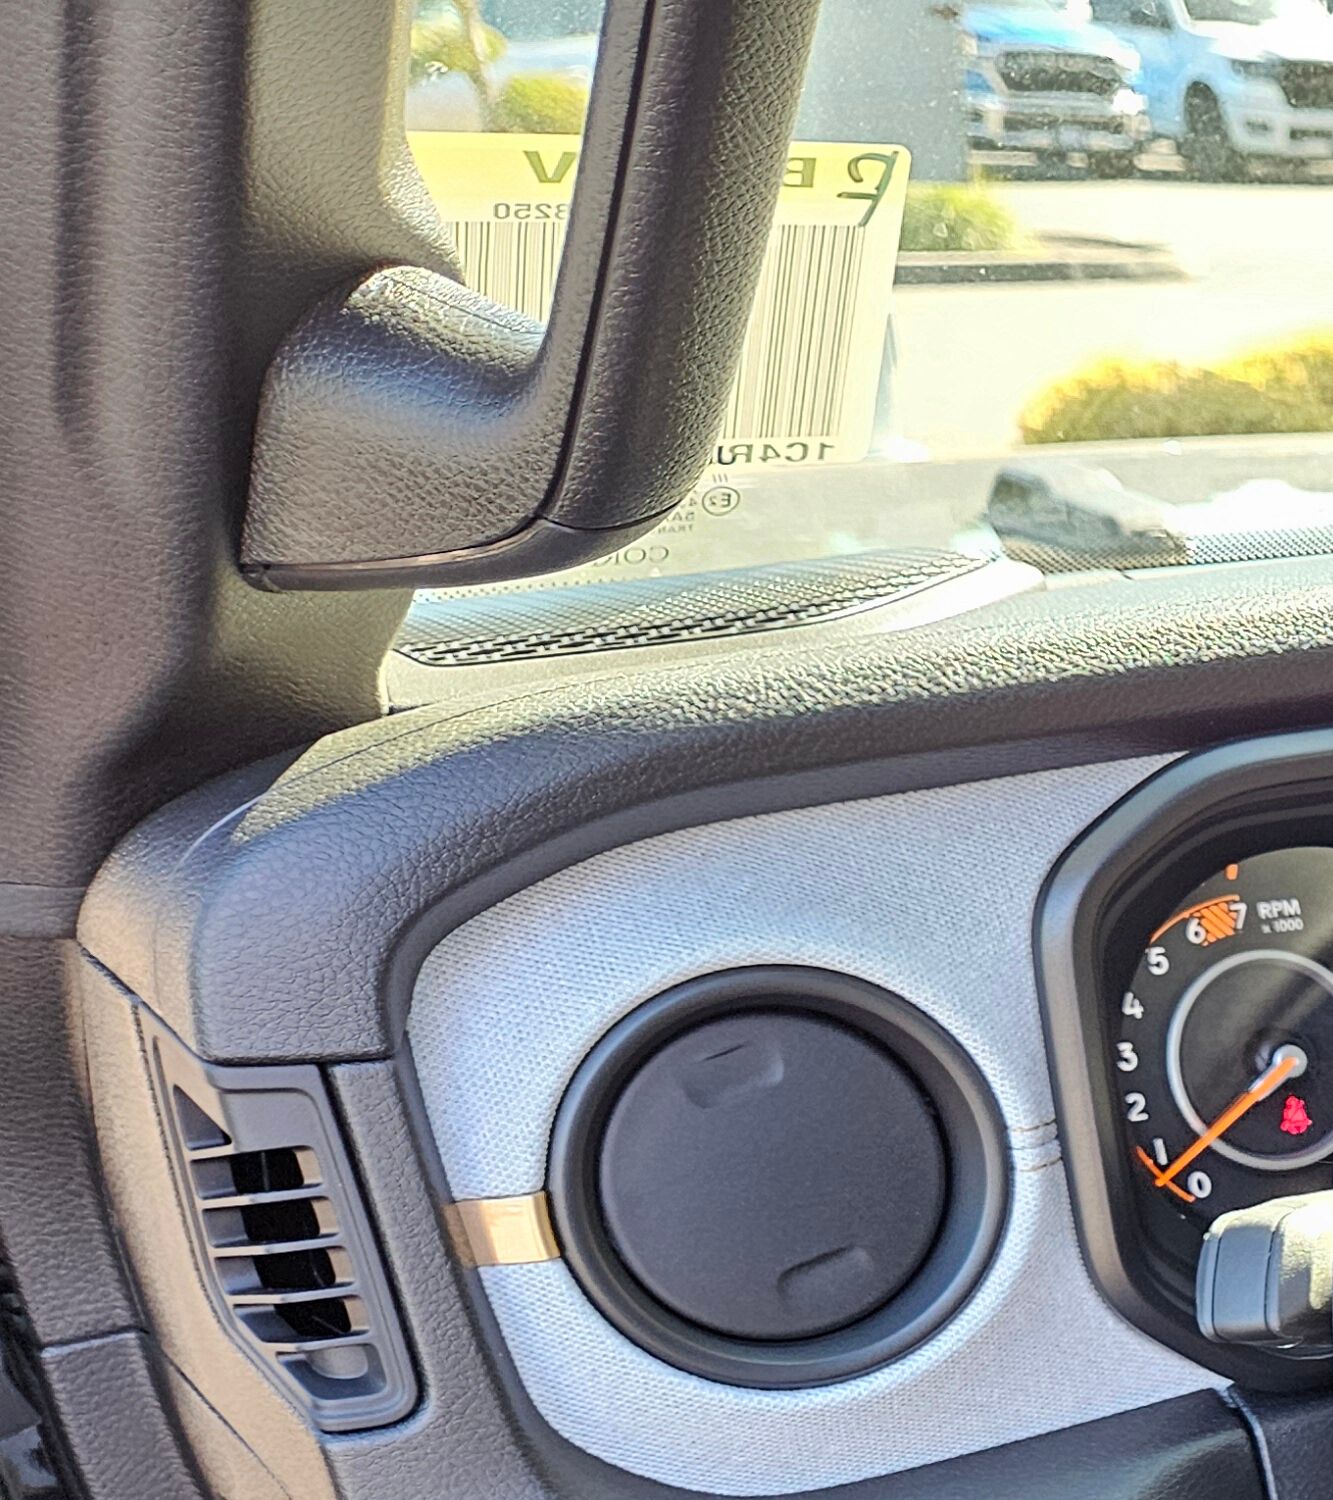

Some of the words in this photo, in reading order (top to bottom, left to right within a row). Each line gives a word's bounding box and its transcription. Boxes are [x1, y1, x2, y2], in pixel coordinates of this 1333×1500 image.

[1230, 903, 1248, 930] 7
[1256, 898, 1302, 920] RPM
[1185, 920, 1207, 945] 6
[1272, 917, 1304, 934] 1000
[1145, 946, 1170, 976] 5
[1121, 991, 1145, 1020] 4
[1116, 1041, 1139, 1072] 3
[1125, 1092, 1149, 1123] 2
[1153, 1137, 1169, 1166] 1
[1187, 1171, 1212, 1199] 0
